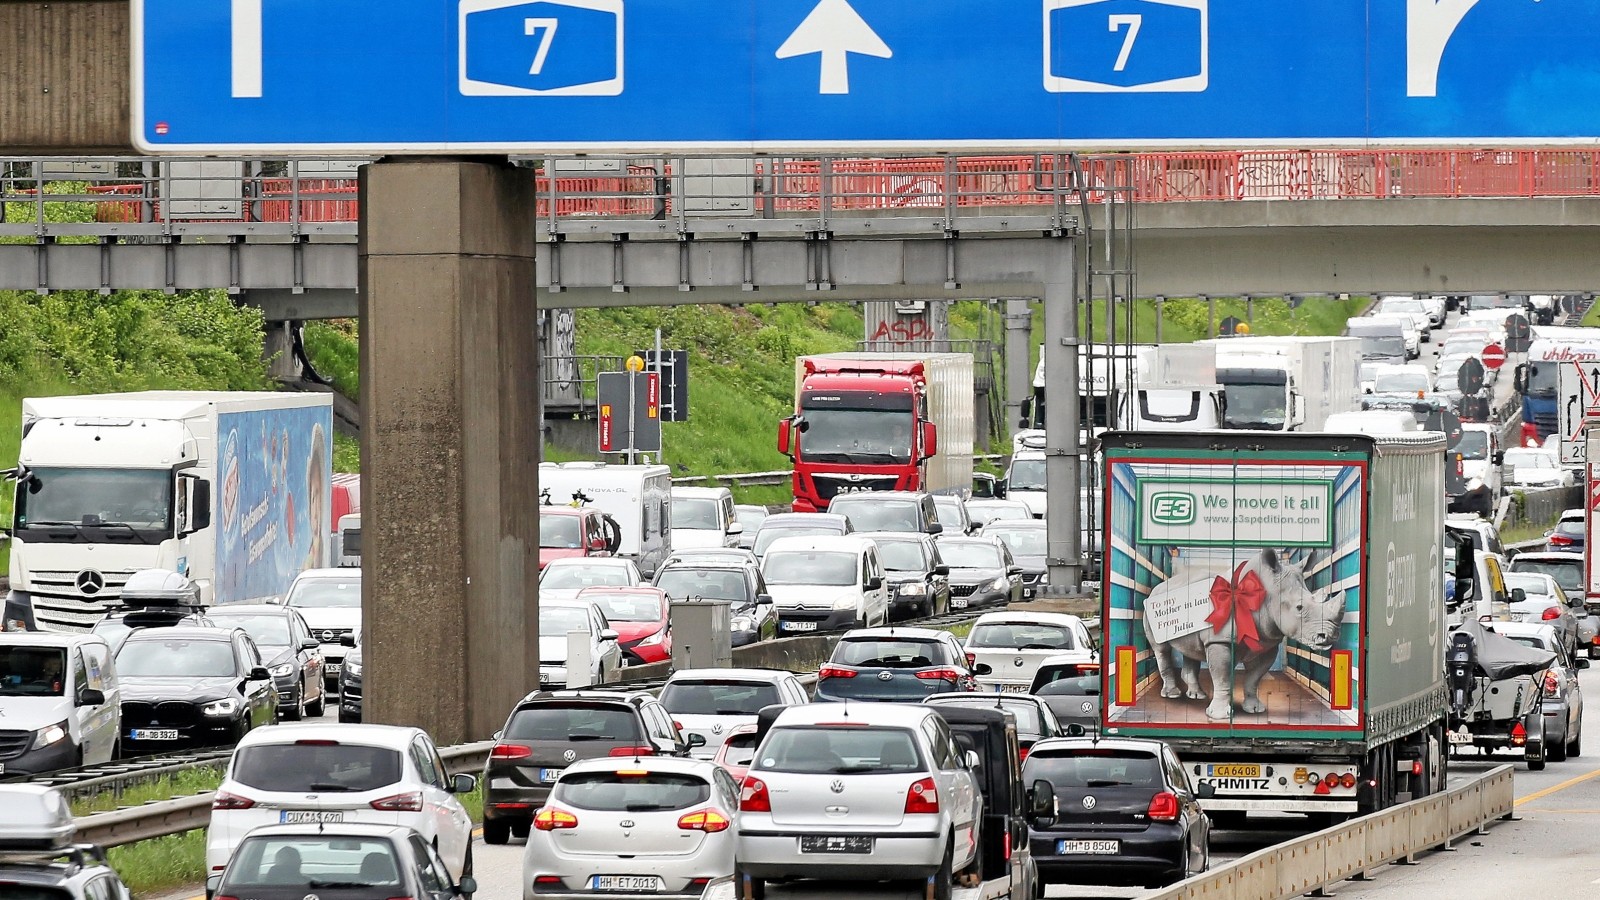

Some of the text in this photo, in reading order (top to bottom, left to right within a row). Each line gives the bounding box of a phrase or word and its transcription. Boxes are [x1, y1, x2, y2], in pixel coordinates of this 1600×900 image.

[524, 17, 559, 75] 7
[1108, 14, 1143, 72] 7
[1202, 494, 1320, 510] We move it all
[1155, 499, 1192, 517] E3
[1203, 514, 1320, 525] www.e3spedition.com
[1150, 602, 1161, 610] To
[1154, 604, 1181, 618] Mother
[1157, 618, 1179, 629] From
[1174, 622, 1194, 634] Julia
[1218, 766, 1229, 775] CA
[1064, 842, 1116, 851] HH B 8504
[600, 878, 656, 888] HH ET 2013
